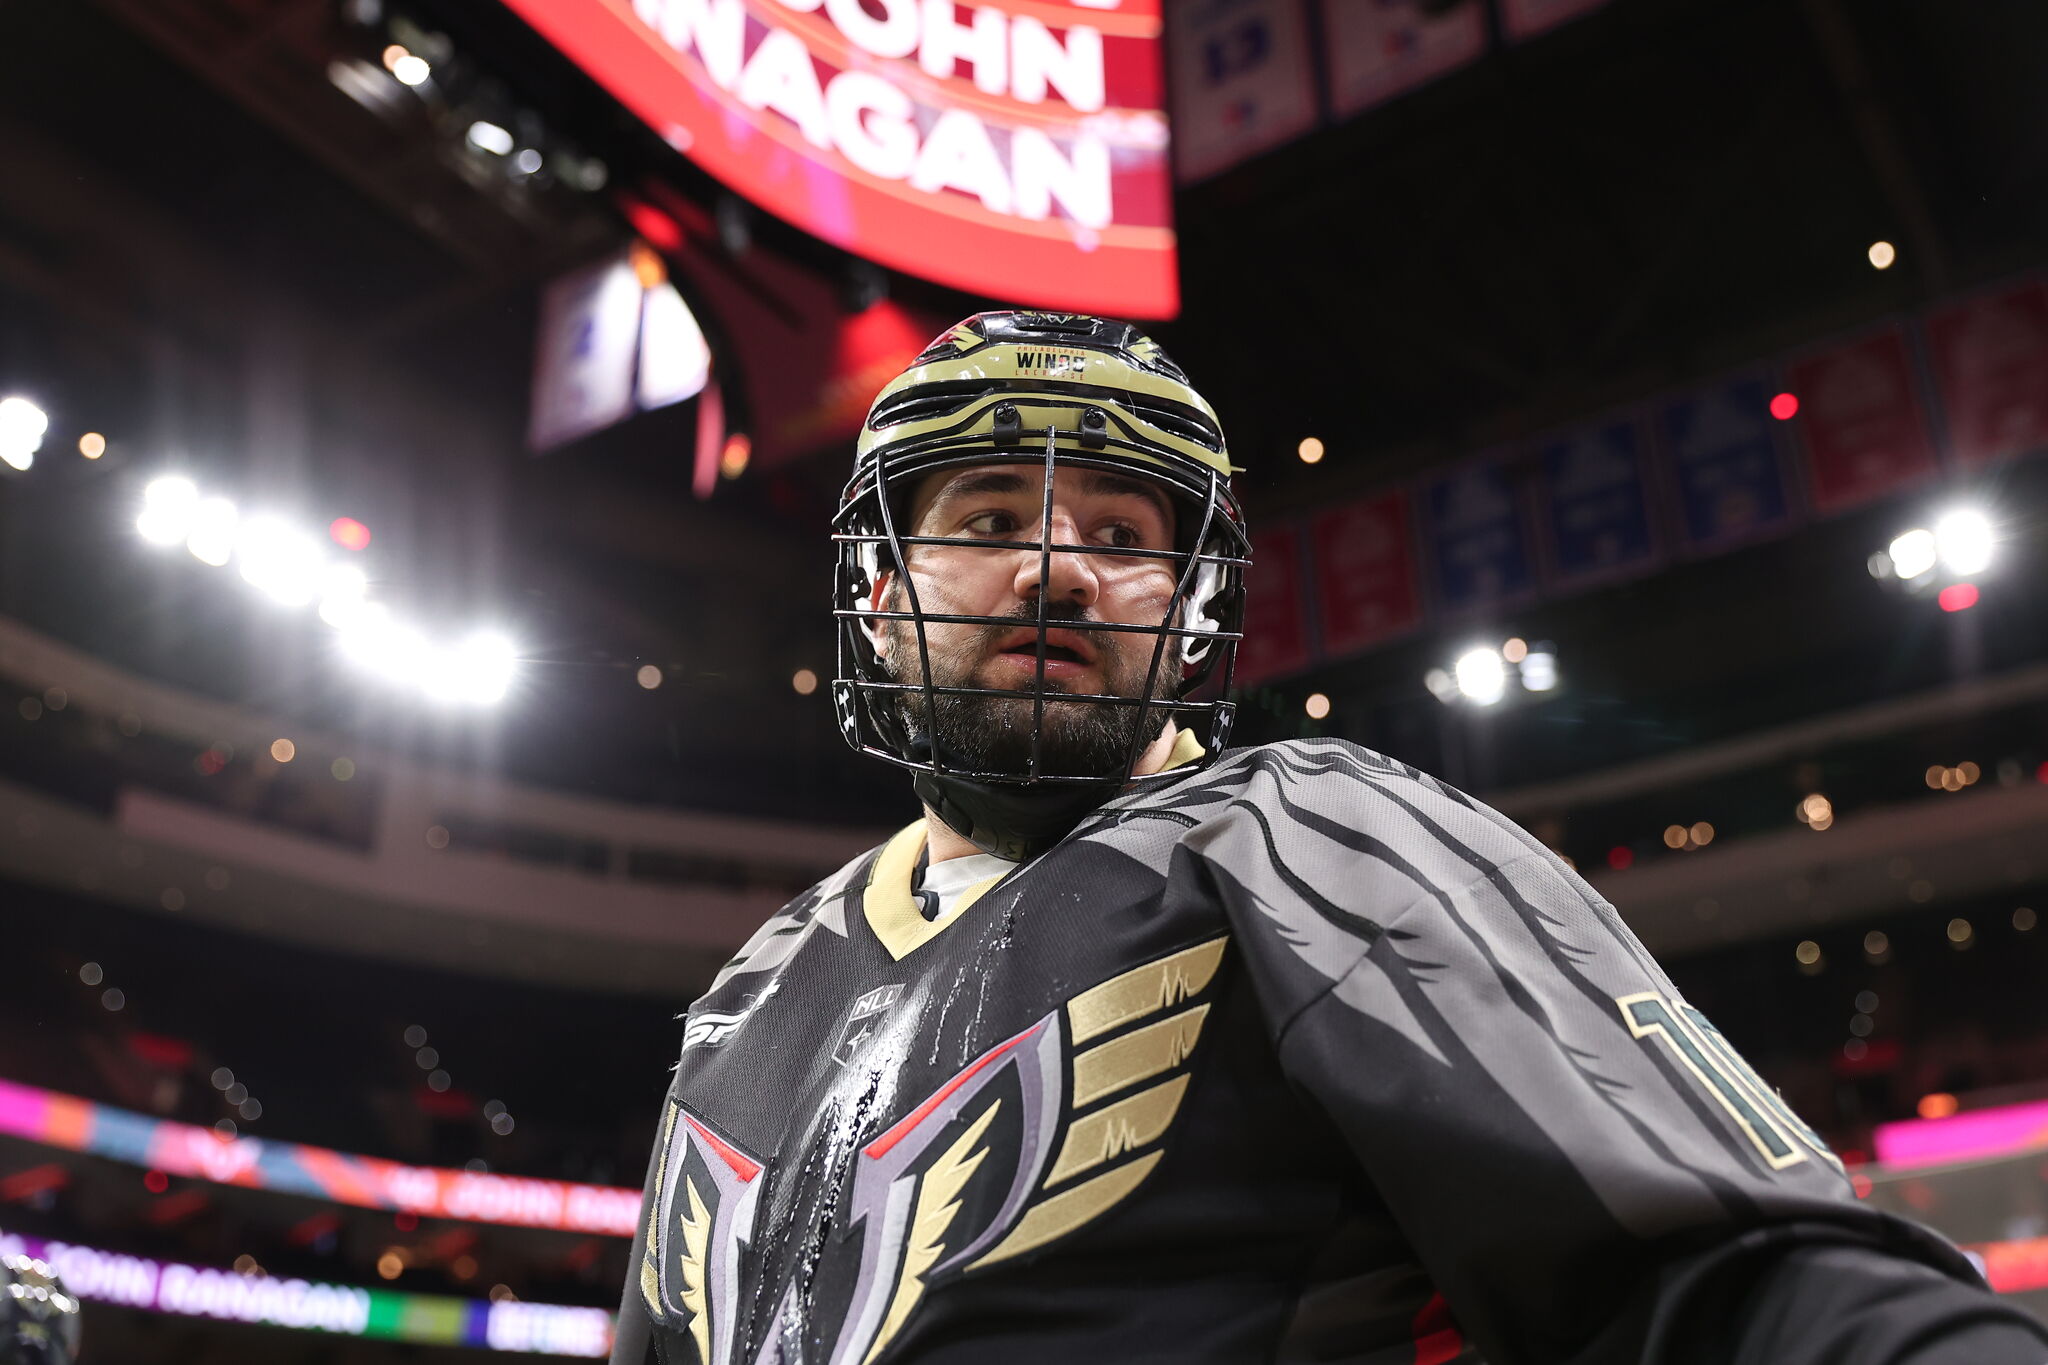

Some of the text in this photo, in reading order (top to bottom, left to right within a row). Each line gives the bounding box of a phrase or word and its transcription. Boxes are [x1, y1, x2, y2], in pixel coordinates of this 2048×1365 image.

[778, 0, 1105, 112] OHN
[630, 0, 1114, 229] NAGAN
[1017, 346, 1086, 356] PHILADELPHIA
[1015, 369, 1085, 380] LACRSSE
[854, 990, 895, 1015] NLL
